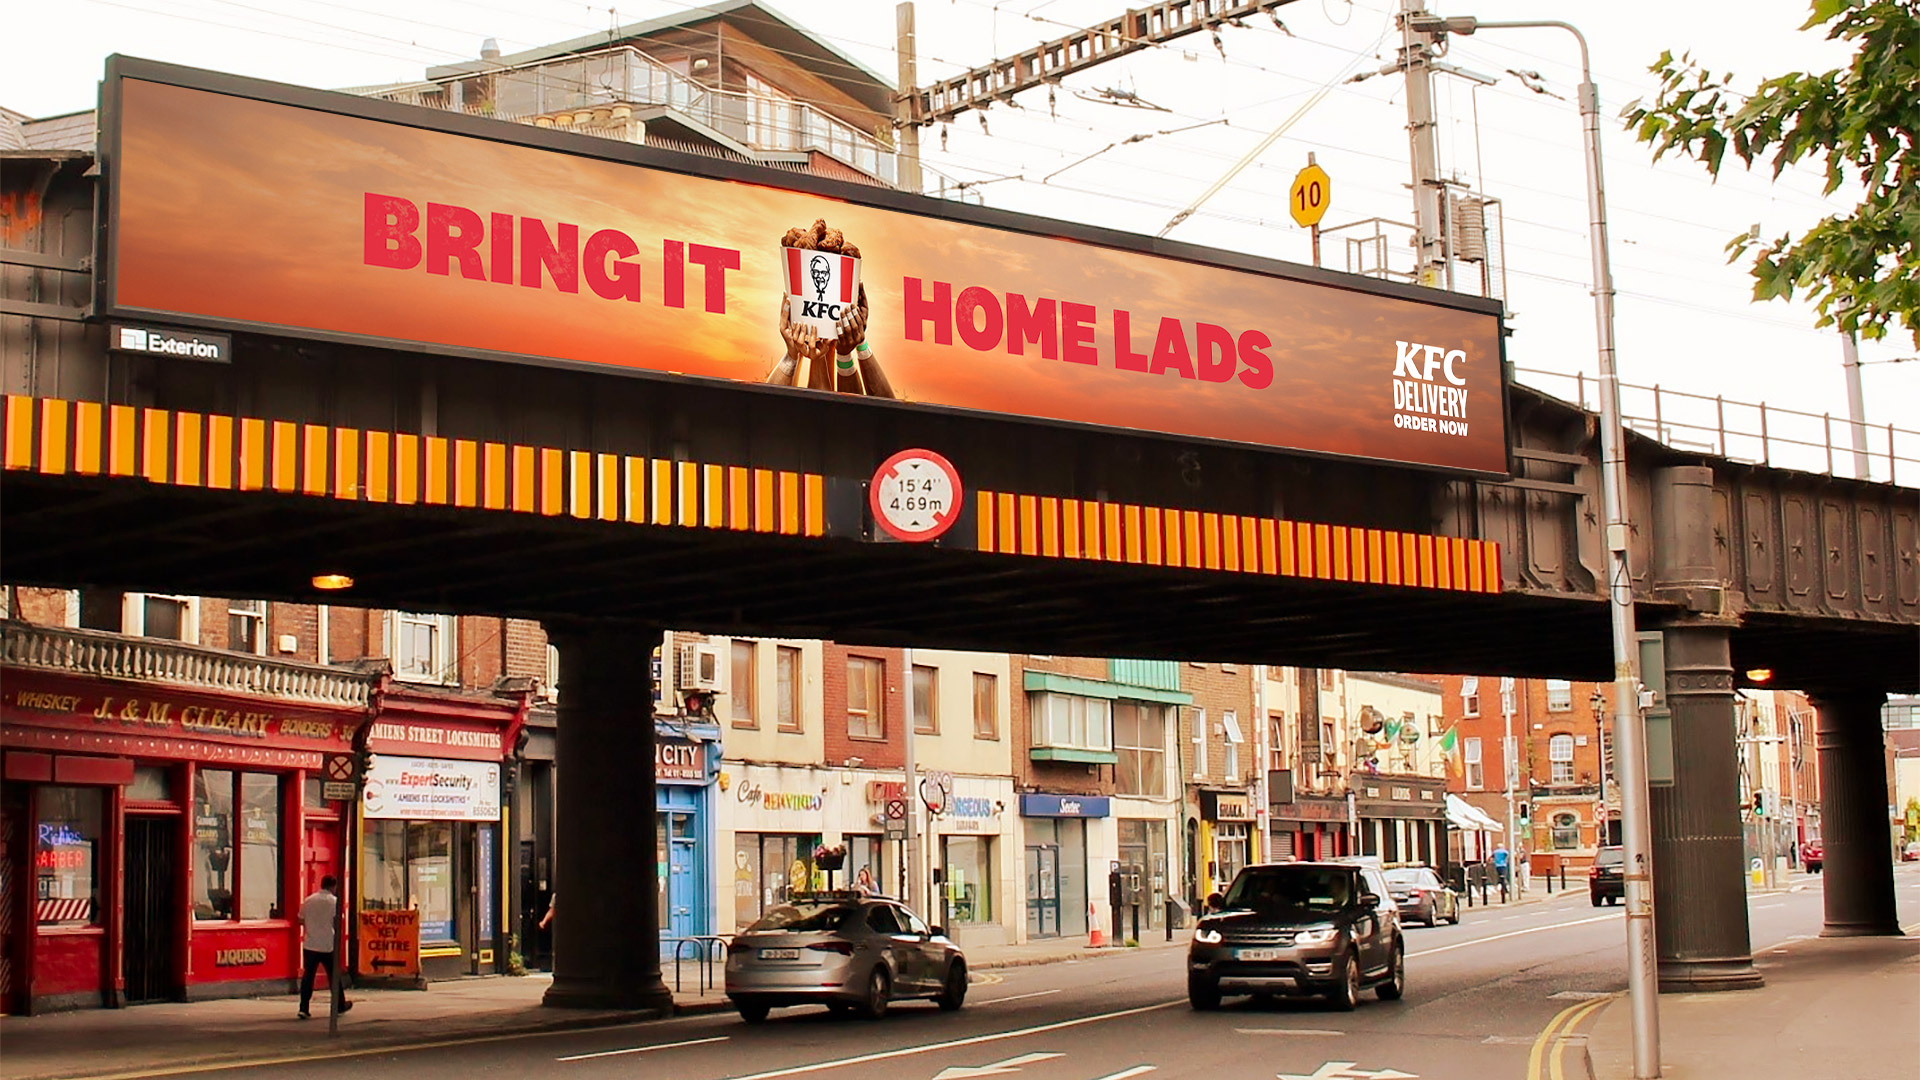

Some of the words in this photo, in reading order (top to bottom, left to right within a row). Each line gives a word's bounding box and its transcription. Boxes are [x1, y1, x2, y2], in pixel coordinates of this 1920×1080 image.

[1297, 181, 1320, 211] 10
[364, 191, 641, 303] BRING
[663, 238, 741, 315] IT
[903, 275, 1098, 367] HOME
[1113, 308, 1274, 390] LADS
[801, 300, 841, 321] KFC
[148, 333, 218, 358] Exterion
[1393, 340, 1466, 386] KFC
[1393, 379, 1468, 418] DELIVERY
[1394, 413, 1437, 432] ORDER
[1439, 419, 1468, 436] NOW
[890, 496, 942, 511] 4.69m
[17, 691, 81, 712] WHISKEY
[120, 699, 139, 722] &
[146, 702, 172, 724] M.
[181, 705, 273, 738] CLEARY
[280, 719, 332, 738] BONDERS
[370, 723, 405, 741] AMIENS
[408, 726, 444, 744] STREET
[447, 729, 501, 749] LOCKSMITHS
[662, 744, 698, 766] CITY
[431, 795, 466, 804] LOCKSMITHS
[362, 914, 414, 926] SECURITY
[378, 927, 399, 938] KEY
[368, 940, 410, 951] CENTRE
[216, 948, 266, 967] LIQUERS
